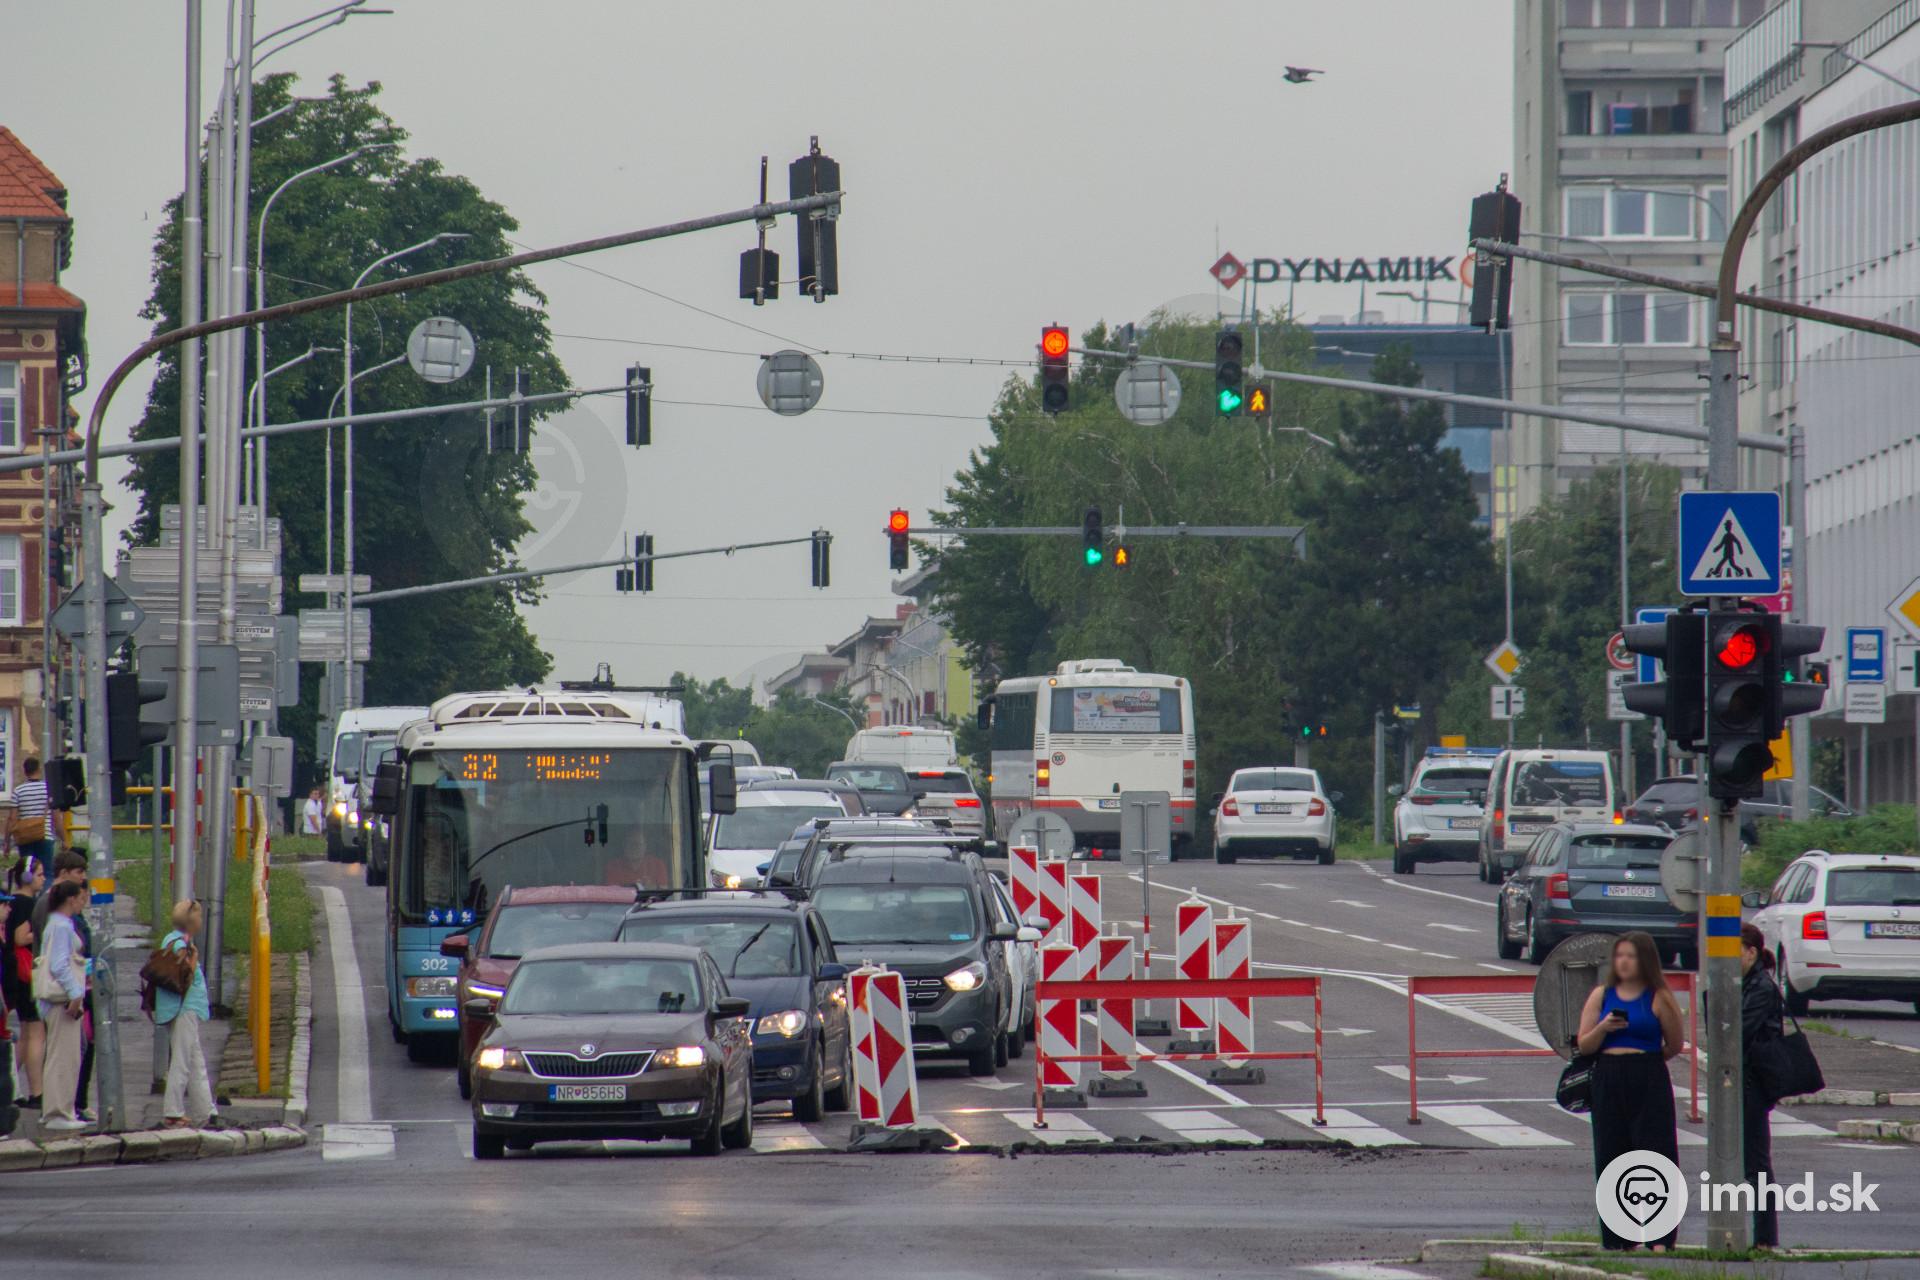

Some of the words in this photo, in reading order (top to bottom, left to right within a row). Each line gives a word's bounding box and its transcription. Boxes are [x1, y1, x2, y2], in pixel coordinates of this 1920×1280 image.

[1252, 256, 1456, 283] DYNAMIK
[463, 753, 497, 780] 32
[421, 958, 448, 971] 302
[558, 1086, 574, 1099] NR
[582, 1086, 624, 1099] 856HS
